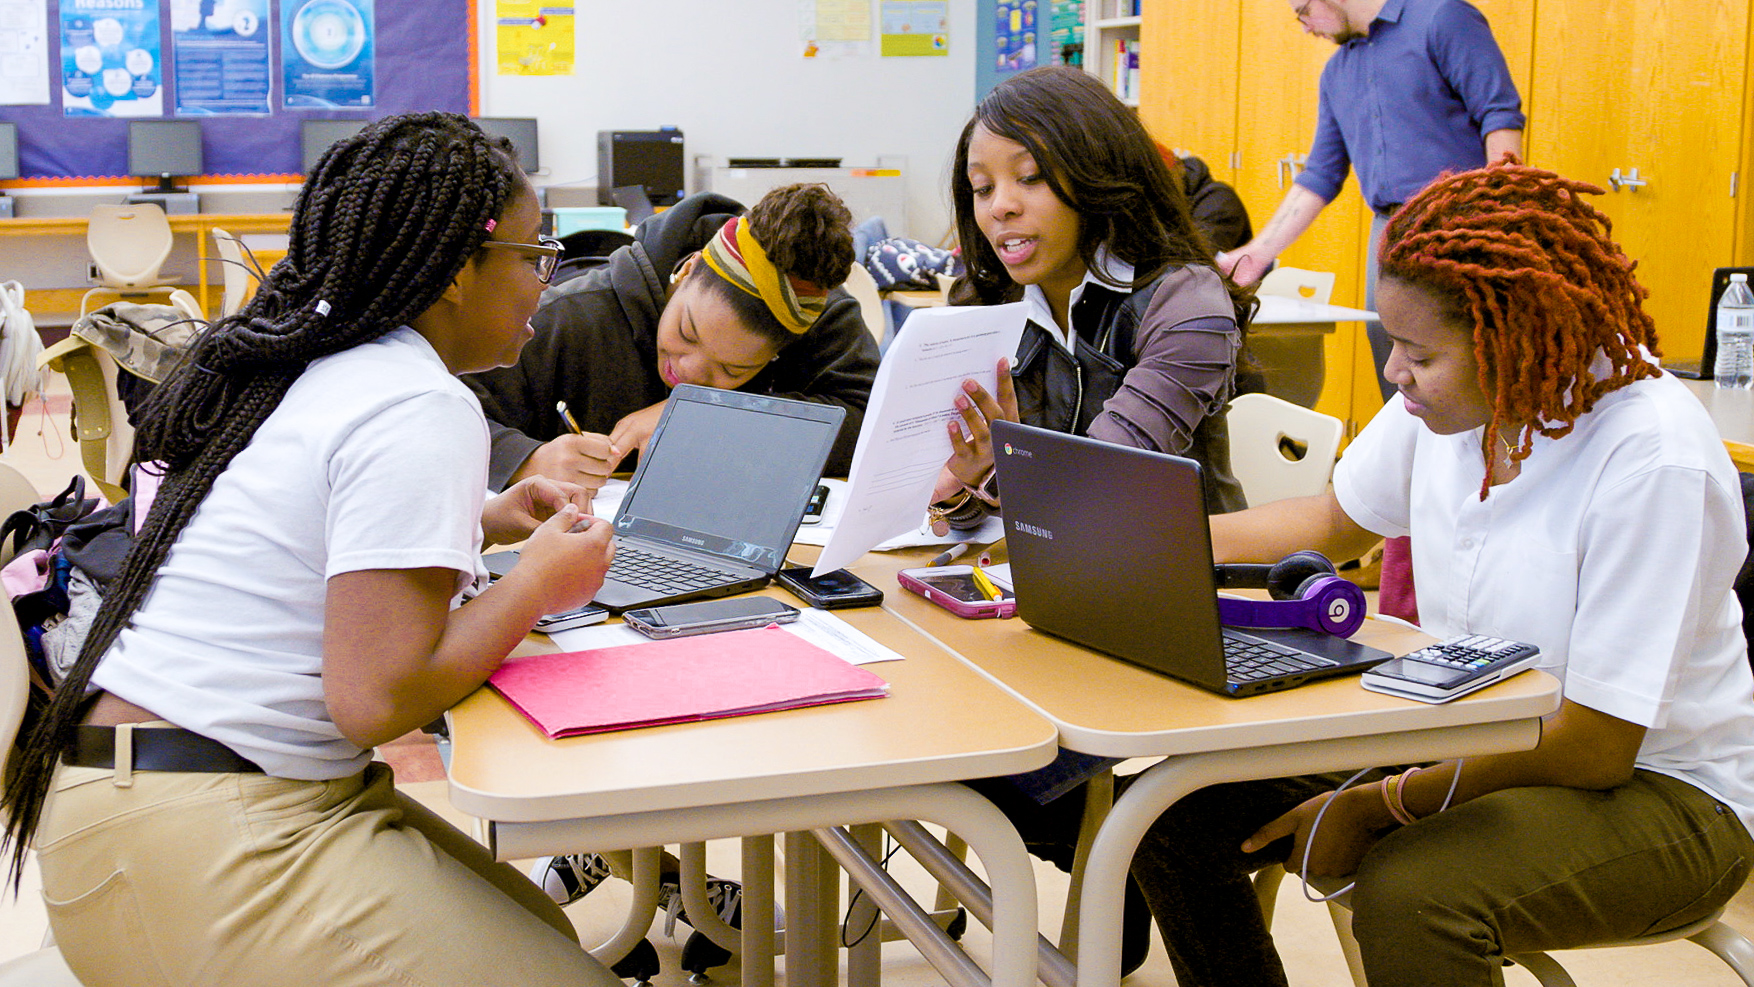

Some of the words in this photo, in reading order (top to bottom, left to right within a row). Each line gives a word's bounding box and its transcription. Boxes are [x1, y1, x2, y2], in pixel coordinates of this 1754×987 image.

[1013, 447, 1033, 458] chrome
[1014, 520, 1053, 540] SAMSUNG
[681, 535, 705, 546] SAMSUNG
